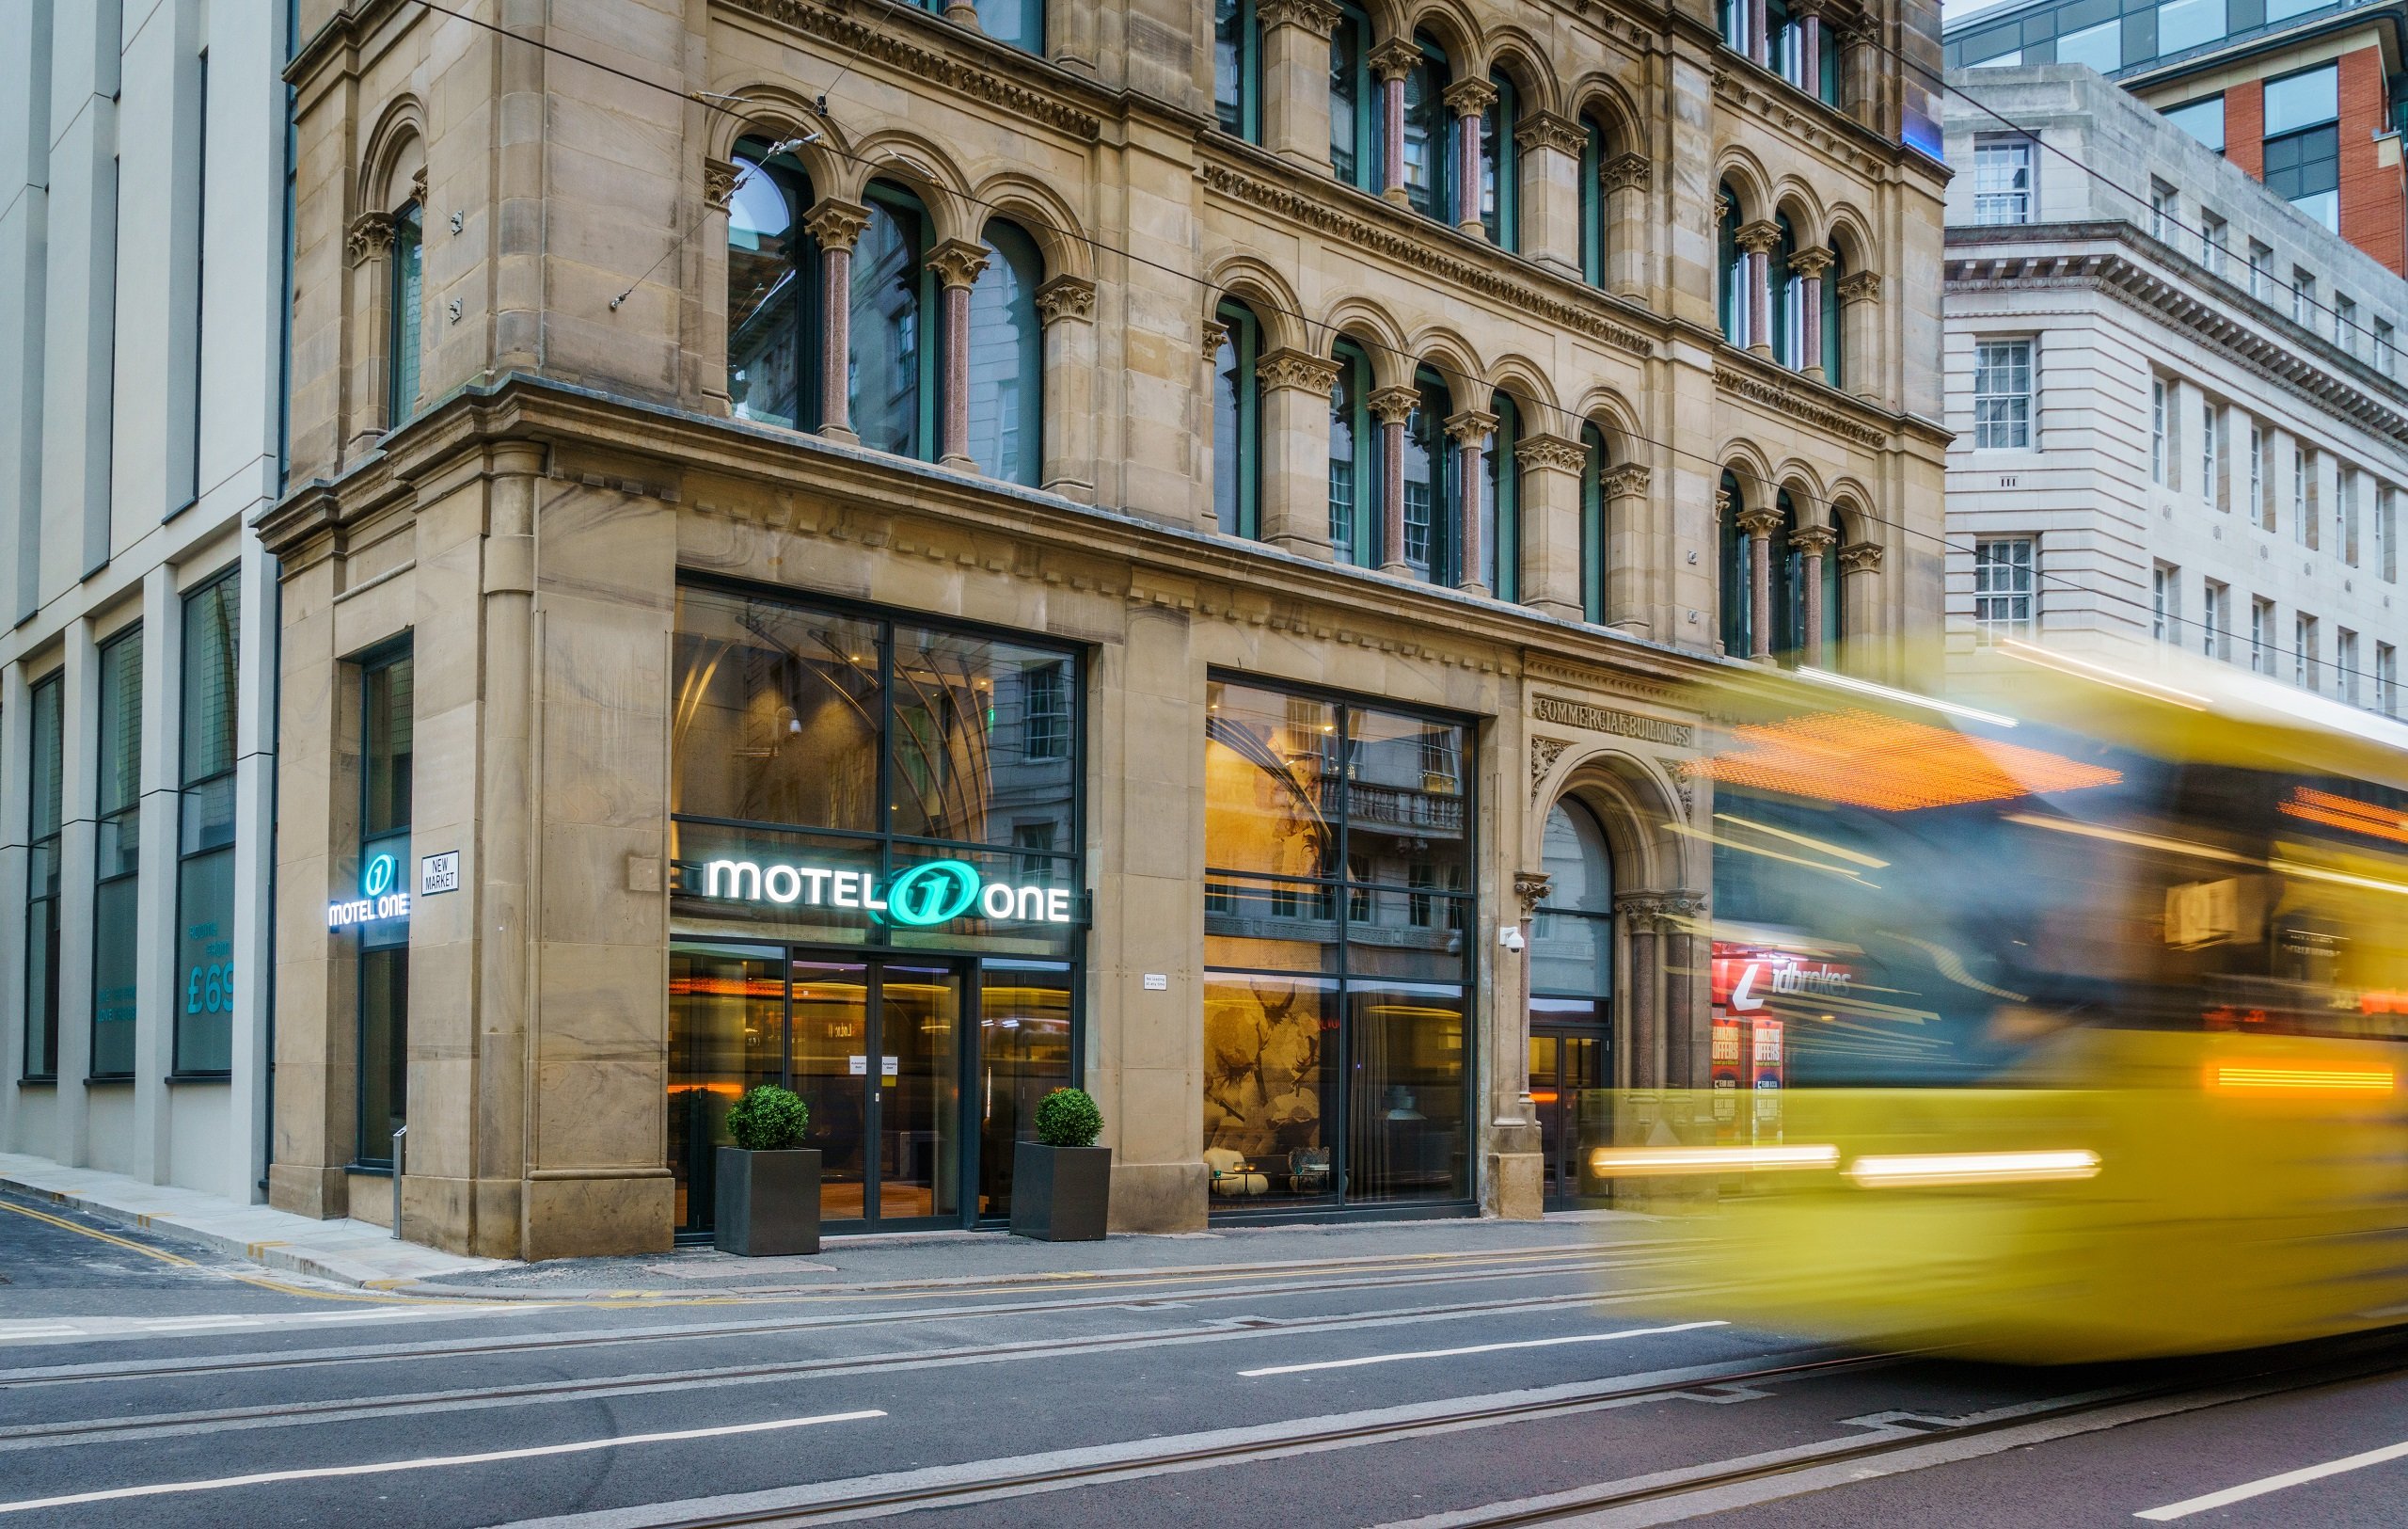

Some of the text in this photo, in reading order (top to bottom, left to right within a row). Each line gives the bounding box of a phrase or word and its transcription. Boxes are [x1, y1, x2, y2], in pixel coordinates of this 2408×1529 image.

[1537, 698, 1690, 746] COMMERCIAL BUILDINGS
[433, 857, 449, 874] NEW
[425, 872, 454, 891] MARKET
[703, 859, 887, 910] MOTEL
[978, 883, 1069, 922] ONE
[328, 893, 408, 926] MOTEL ONE
[187, 962, 234, 1014] £69
[1713, 1027, 1738, 1042] AMAZING
[1755, 1028, 1780, 1043] AMAZING
[1713, 1042, 1738, 1059] OFFERS
[1755, 1043, 1780, 1061] OFFERS
